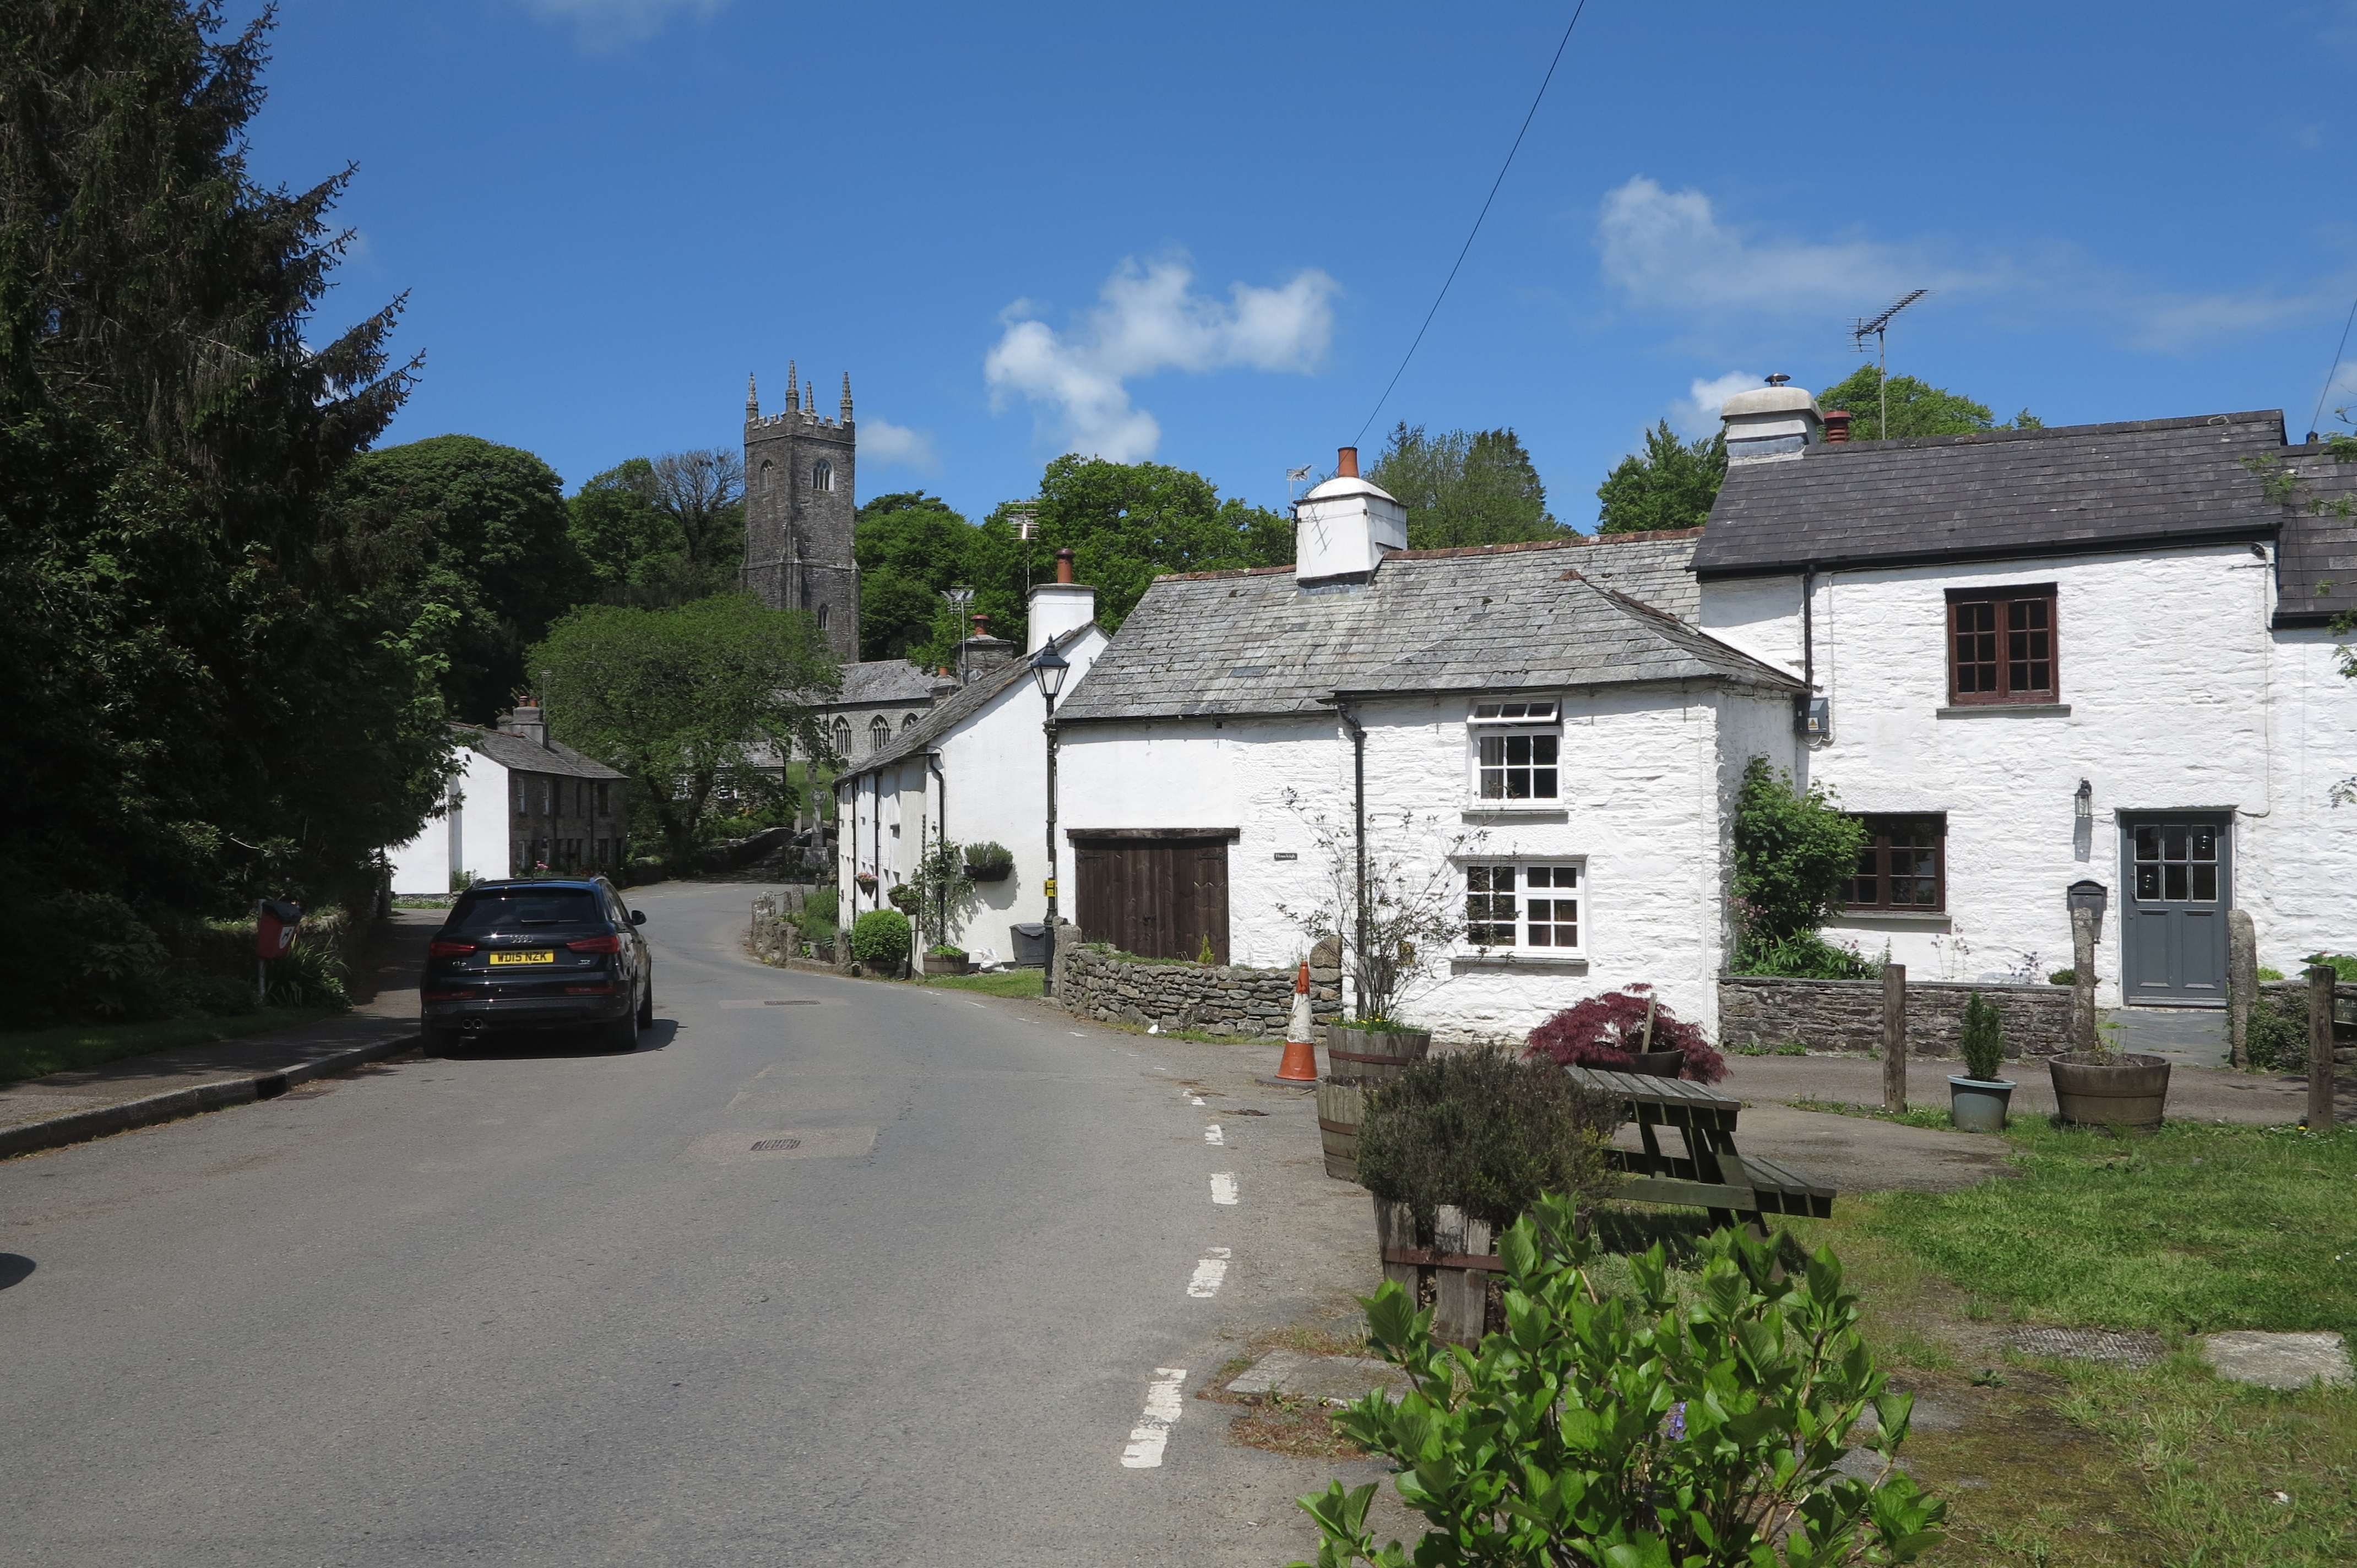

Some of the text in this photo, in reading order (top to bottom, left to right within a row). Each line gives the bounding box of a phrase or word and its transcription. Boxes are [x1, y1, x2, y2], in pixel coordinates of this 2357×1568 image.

[1045, 881, 1055, 895] H
[497, 951, 547, 962] WD15 NZK
